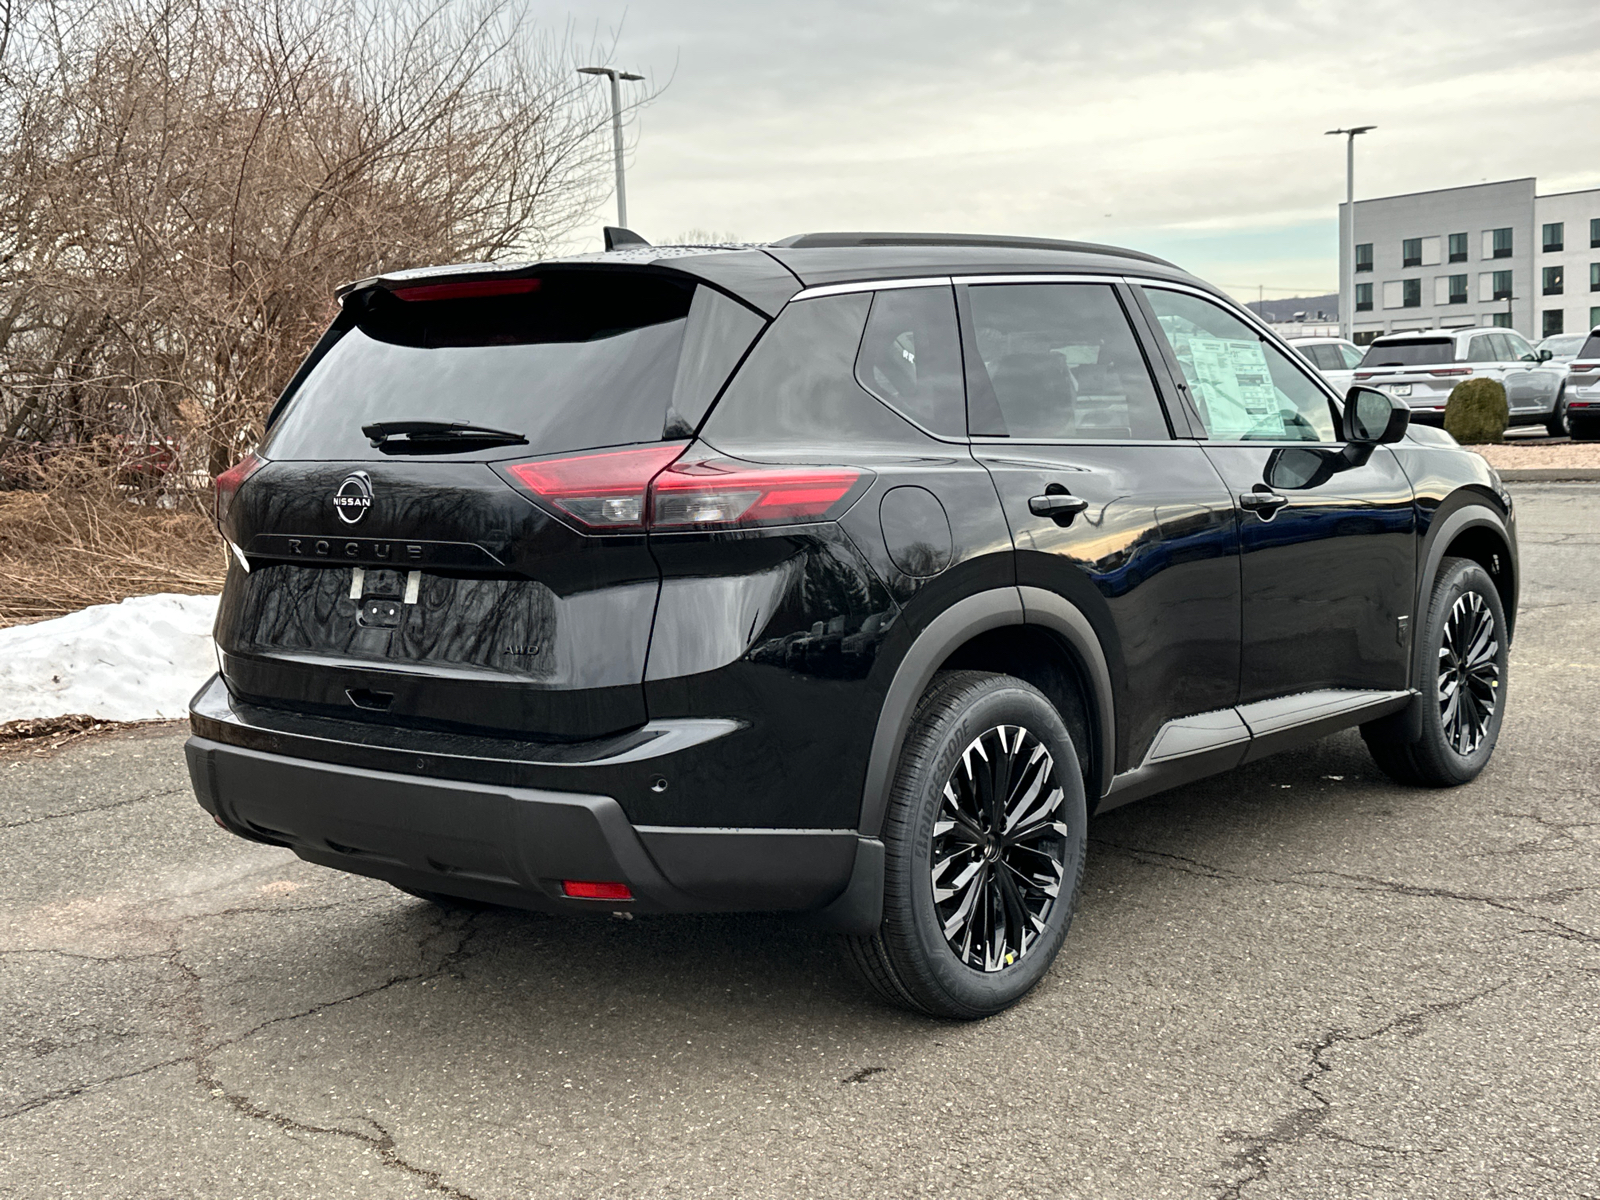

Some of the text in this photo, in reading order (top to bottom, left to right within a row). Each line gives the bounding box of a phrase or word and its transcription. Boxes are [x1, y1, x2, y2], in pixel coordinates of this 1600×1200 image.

[333, 497, 371, 507] NISSAN
[288, 538, 422, 559] ROGUE
[503, 645, 540, 656] AWD
[914, 718, 970, 859] BRIDGESTONE
